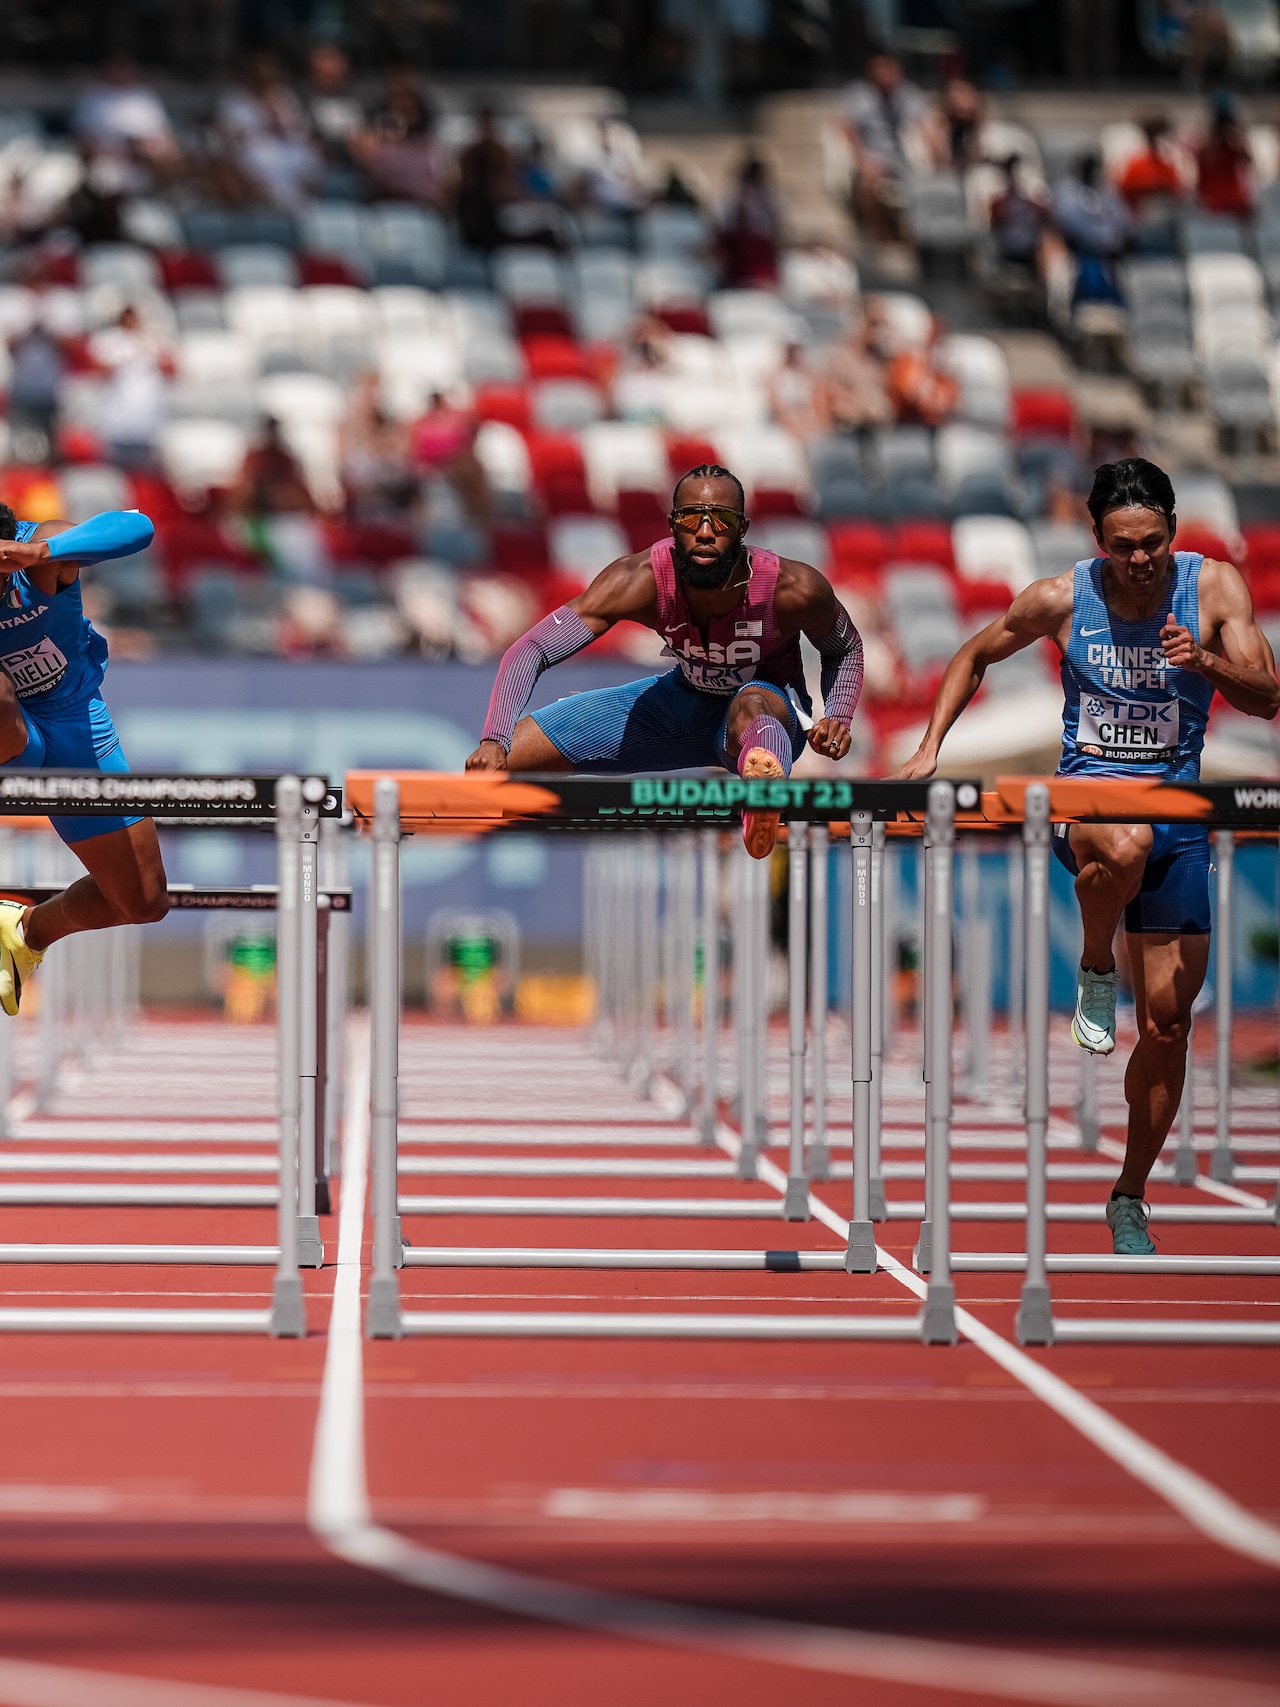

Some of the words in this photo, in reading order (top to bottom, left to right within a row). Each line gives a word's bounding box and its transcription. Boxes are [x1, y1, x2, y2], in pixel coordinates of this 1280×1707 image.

[1099, 667, 1166, 690] TAIPEI
[1106, 700, 1172, 722] TDK
[1099, 723, 1158, 745] CHEN
[1105, 750, 1159, 760] BUDAPEST
[1160, 750, 1172, 759] 23
[0, 777, 101, 799] ATHLETICS
[99, 778, 257, 800] CHAMPIONSHIPS
[631, 779, 810, 807] BUDAPEST
[813, 781, 853, 808] 23
[1233, 787, 1280, 809] WOR
[302, 864, 313, 902] MONDO
[856, 869, 867, 906] MONDO
